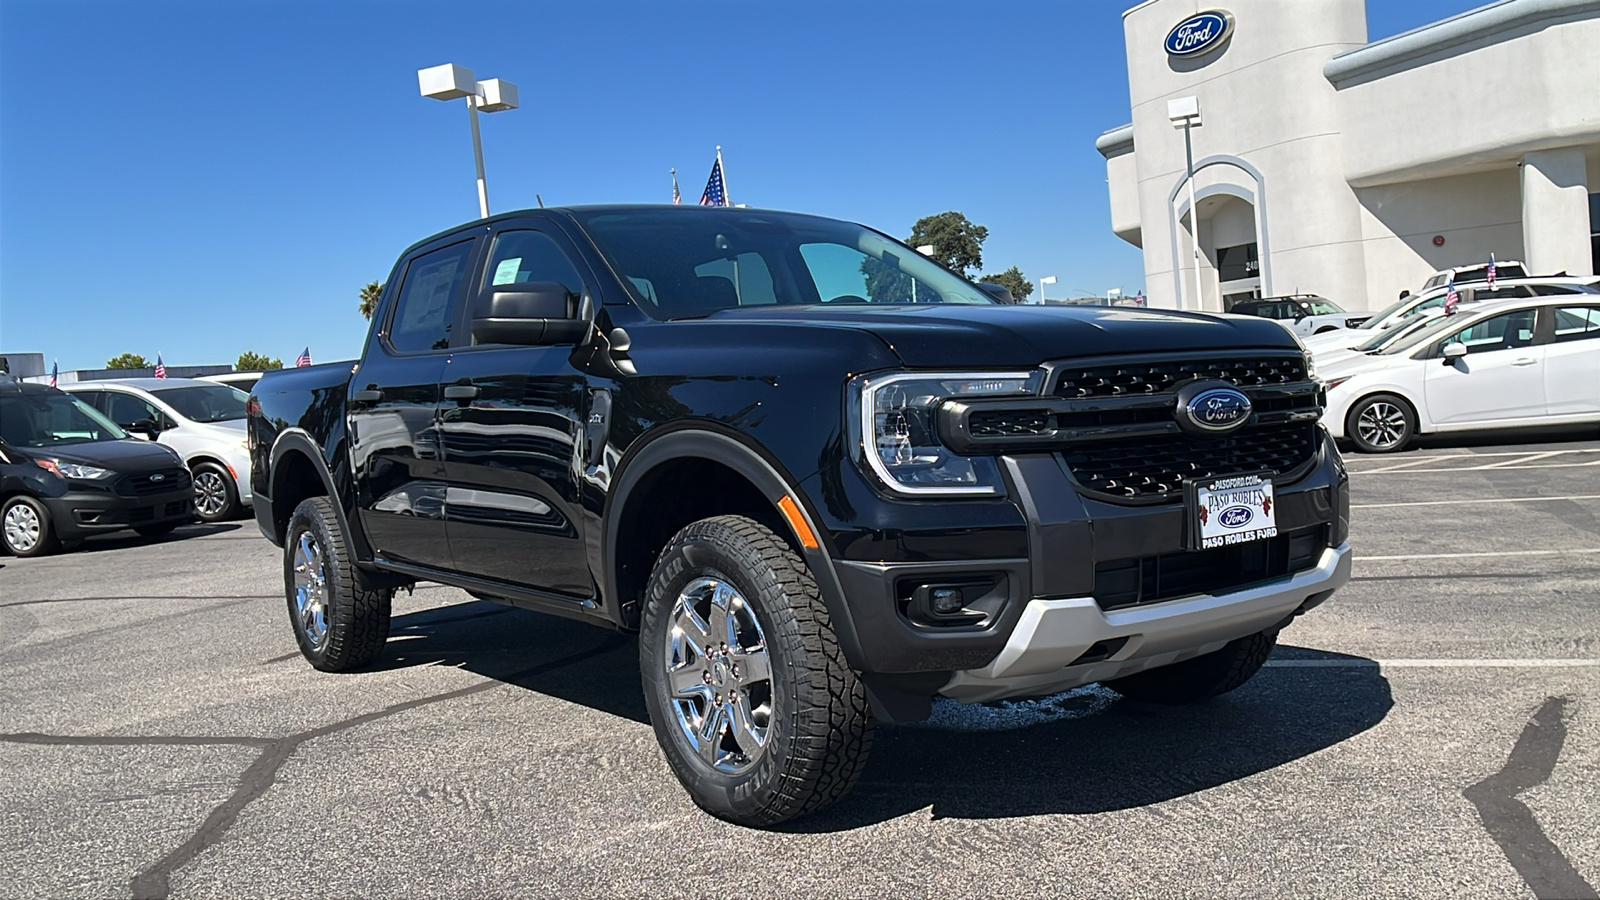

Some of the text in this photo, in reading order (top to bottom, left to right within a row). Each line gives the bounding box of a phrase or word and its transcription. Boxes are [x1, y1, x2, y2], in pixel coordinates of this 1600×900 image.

[1175, 20, 1212, 50] Ford
[1206, 397, 1239, 420] Ford
[1208, 488, 1263, 514] PASO ROBLES
[1225, 509, 1248, 525] Ford
[1202, 527, 1278, 549] PASO ROBLES FORD
